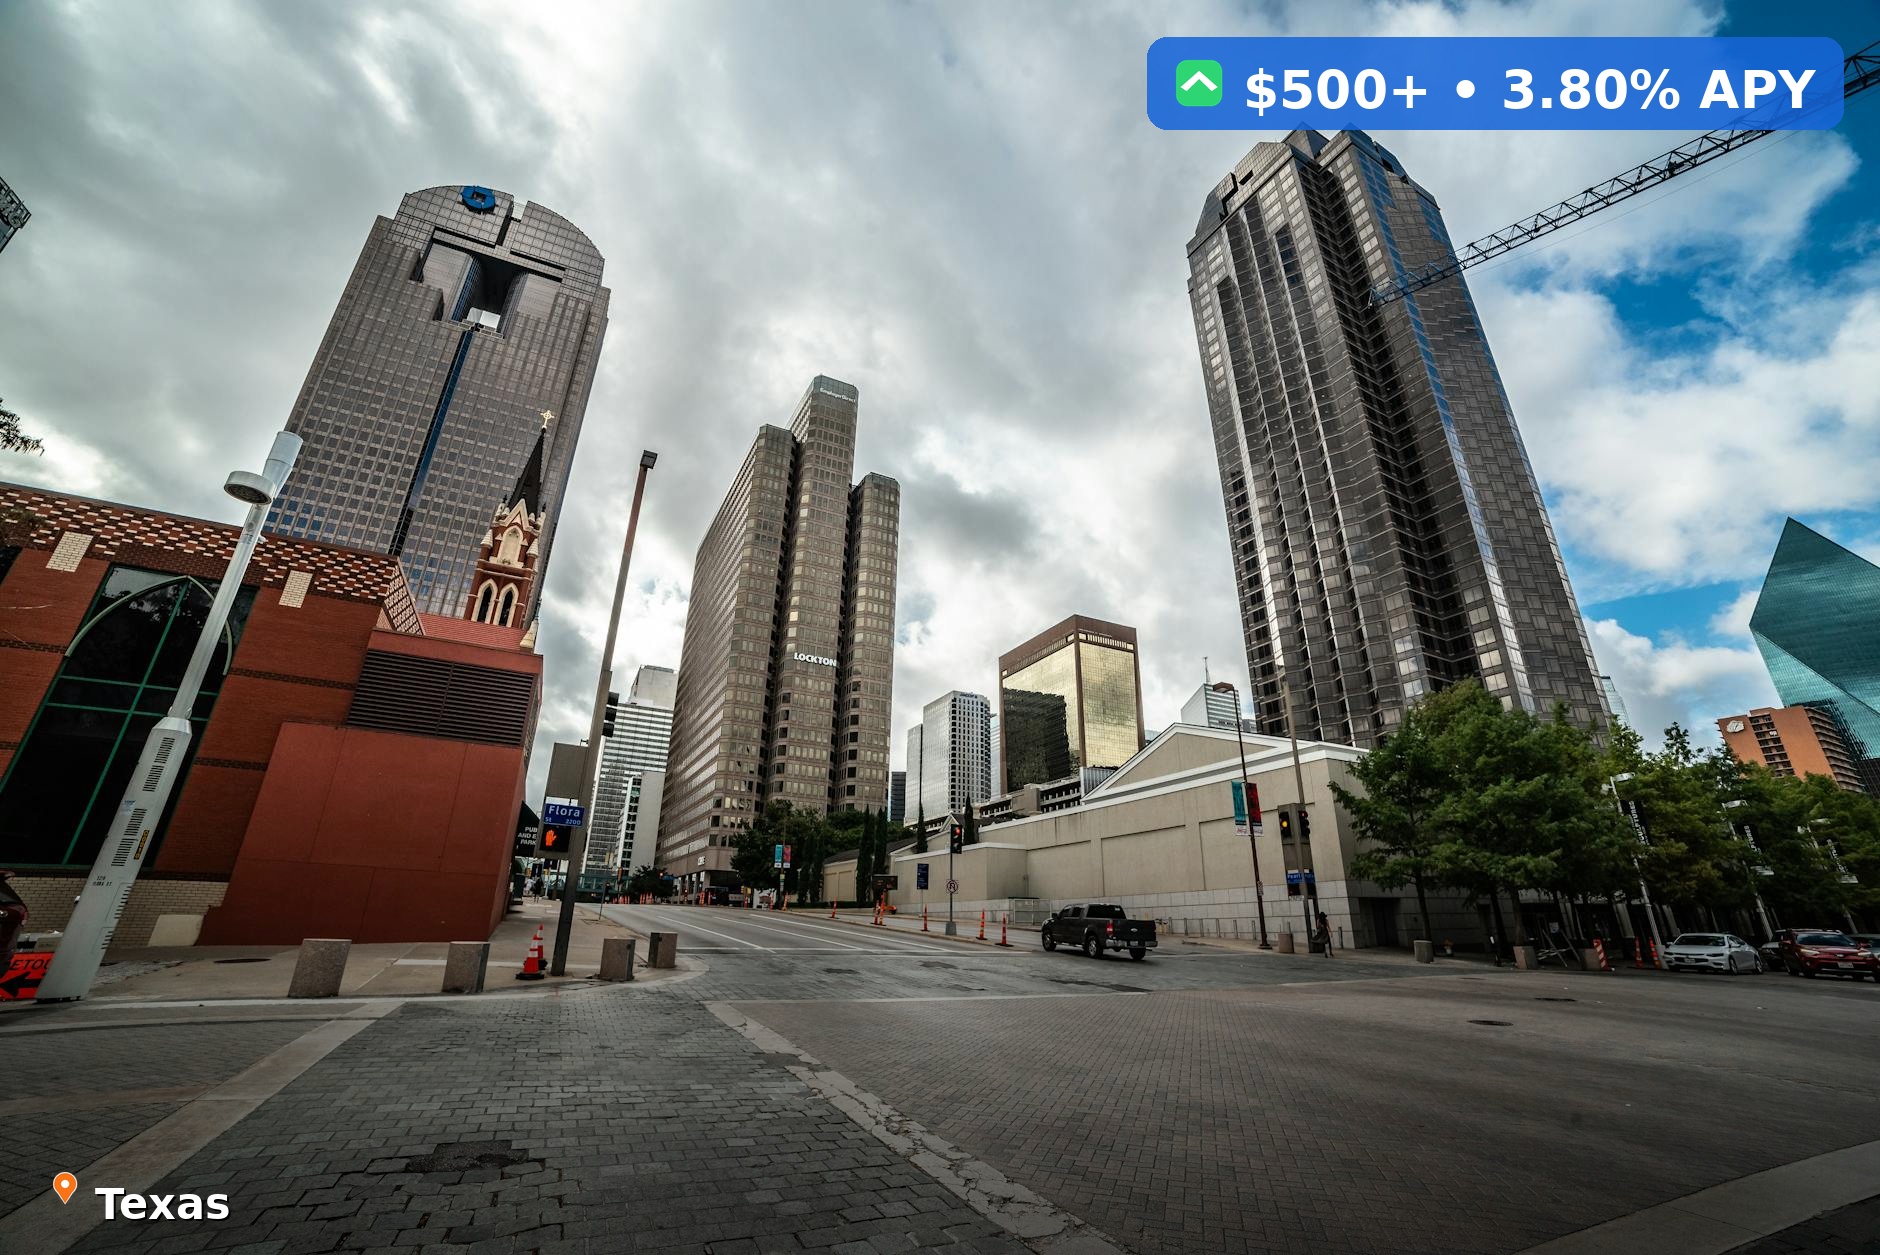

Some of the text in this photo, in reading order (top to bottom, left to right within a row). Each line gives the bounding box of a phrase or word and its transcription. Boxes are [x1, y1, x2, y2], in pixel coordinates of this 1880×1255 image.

[794, 652, 837, 667] LOCKTON
[548, 805, 580, 817] Flora
[565, 818, 581, 826] 2200
